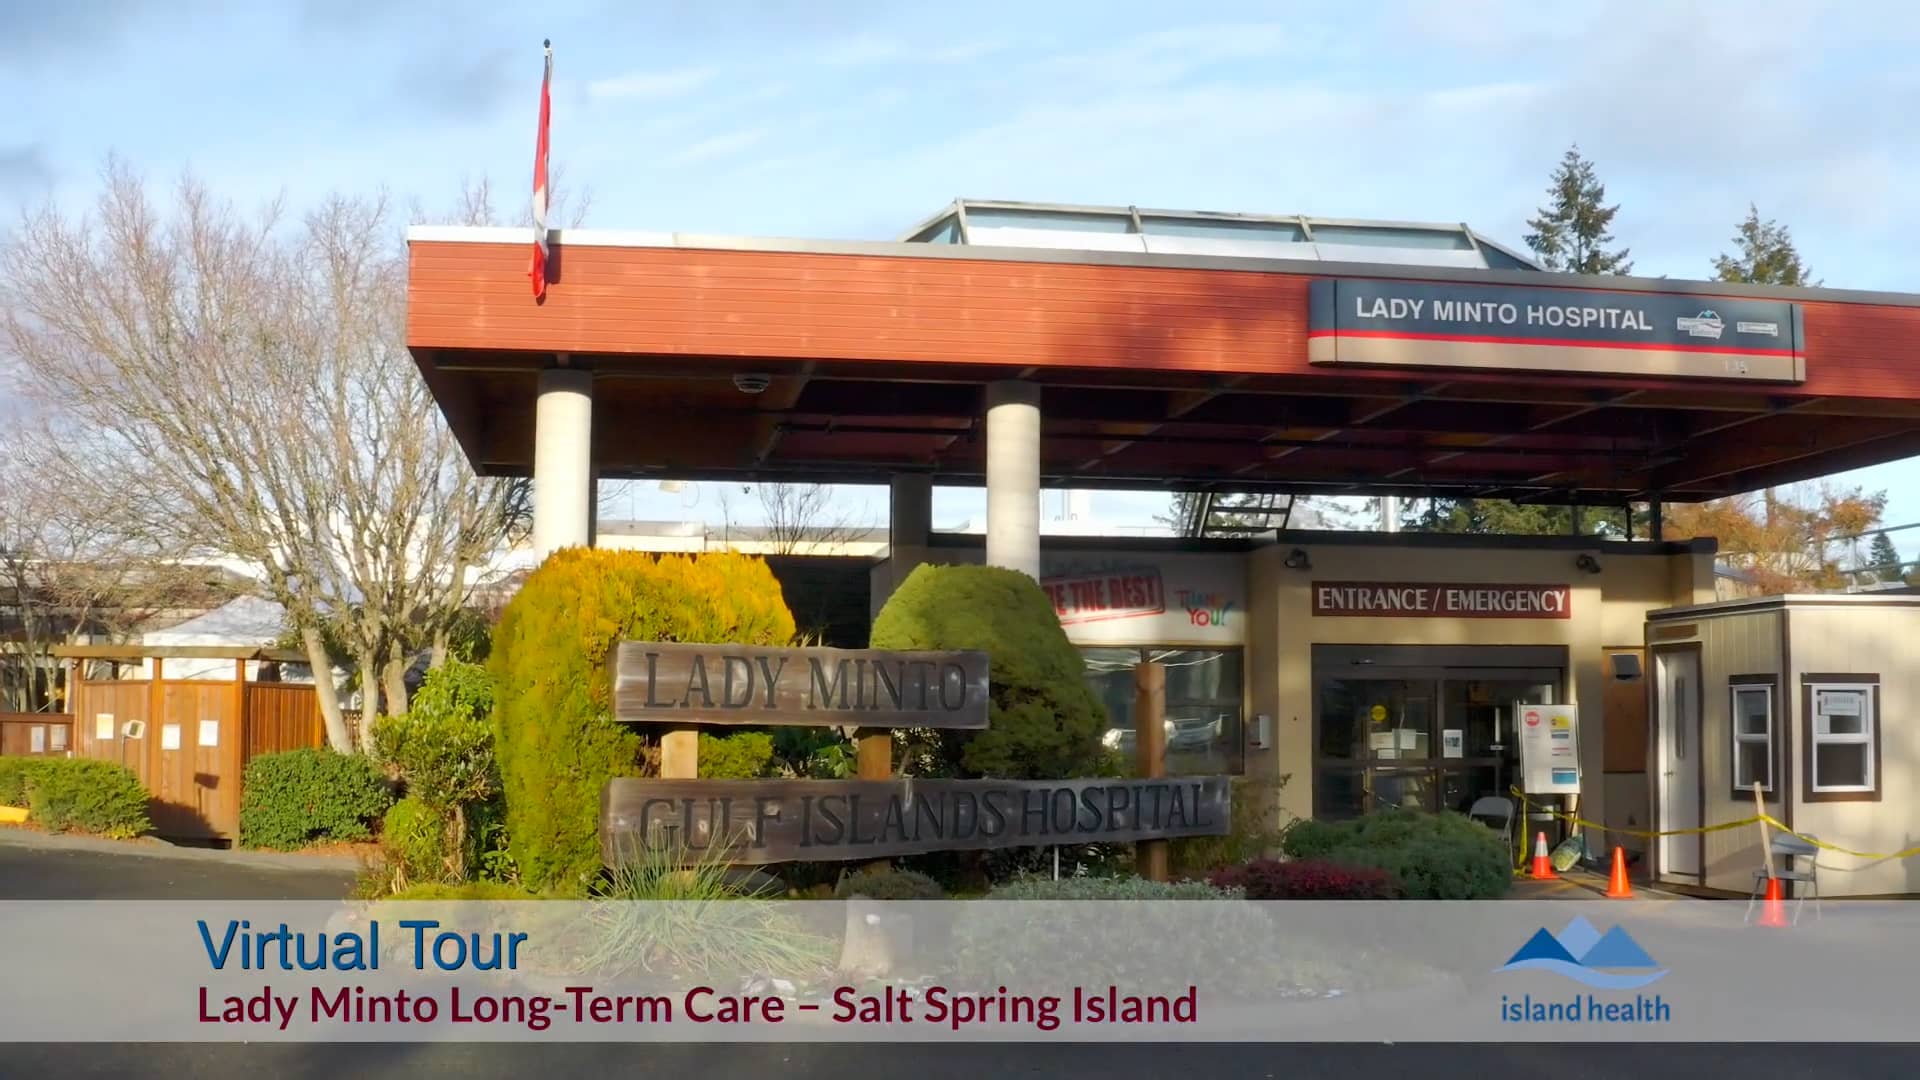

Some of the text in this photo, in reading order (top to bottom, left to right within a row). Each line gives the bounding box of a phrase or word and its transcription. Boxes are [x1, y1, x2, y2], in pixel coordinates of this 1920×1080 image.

[1356, 297, 1424, 320] LADY
[1433, 300, 1518, 325] MINTO
[1527, 305, 1653, 331] HOSPITAL
[1068, 580, 1106, 614] THE
[1108, 575, 1158, 610] BEST
[1318, 587, 1428, 610] ENTRANCE
[1446, 589, 1566, 613] EMERGENCY
[643, 652, 968, 714] LADY MINTO
[640, 782, 1213, 852] GULF ISLANDS HOSPITAL
